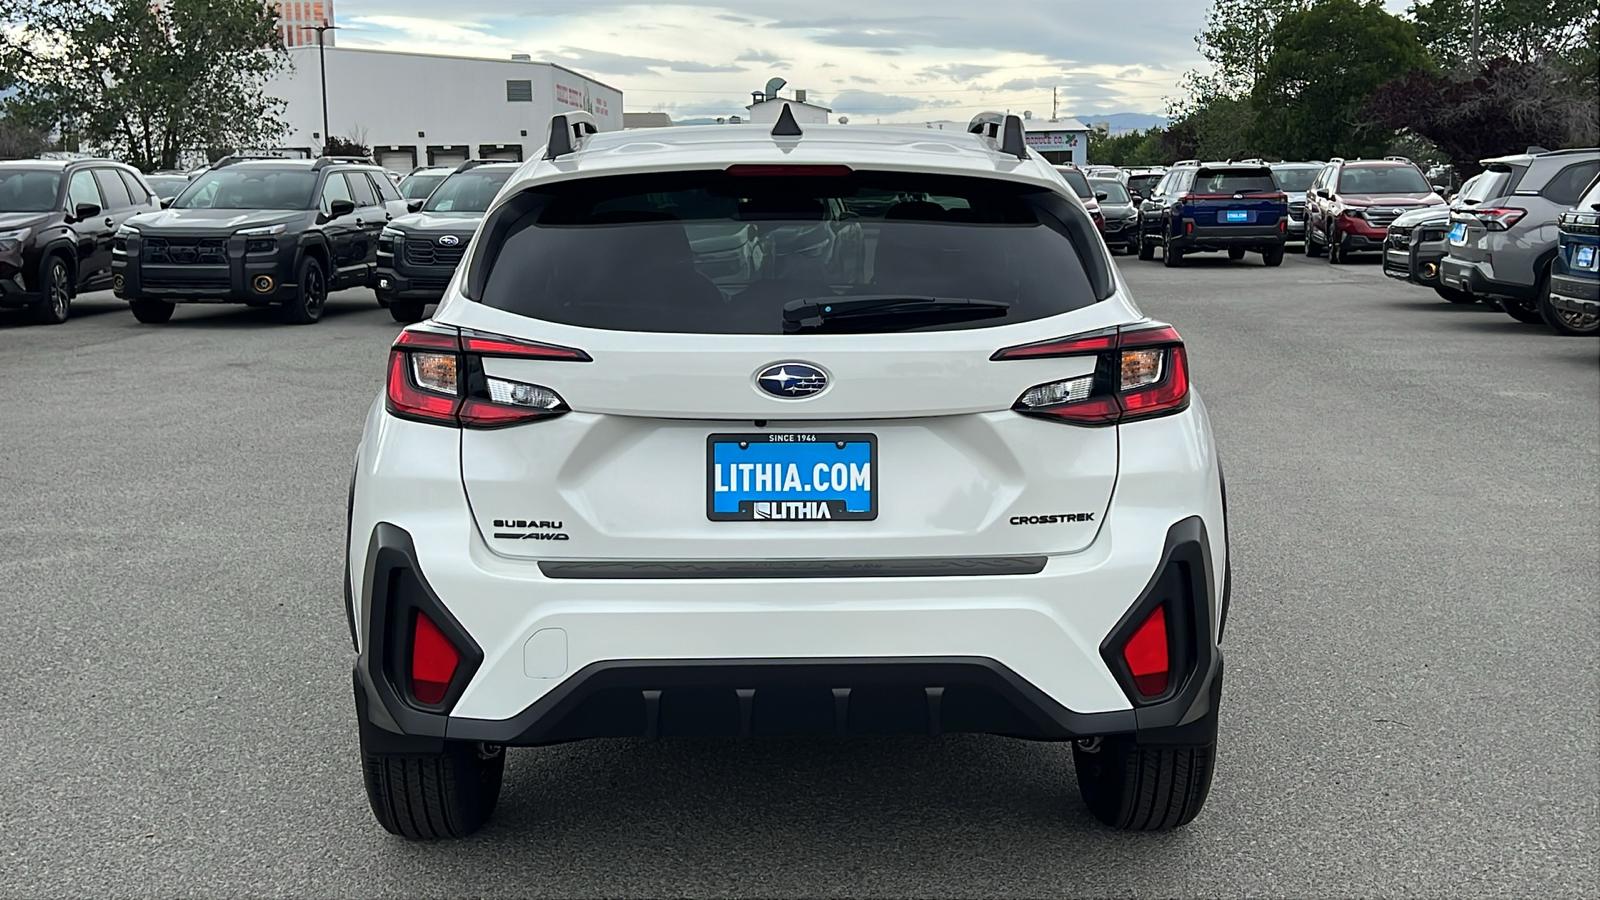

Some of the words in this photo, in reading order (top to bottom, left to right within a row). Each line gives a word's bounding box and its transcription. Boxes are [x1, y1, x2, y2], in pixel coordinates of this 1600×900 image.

[715, 463, 870, 492] LITHIA.COM
[772, 502, 831, 519] LITHIA
[493, 520, 563, 529] SUBARU
[1010, 512, 1095, 525] CROSSTREK
